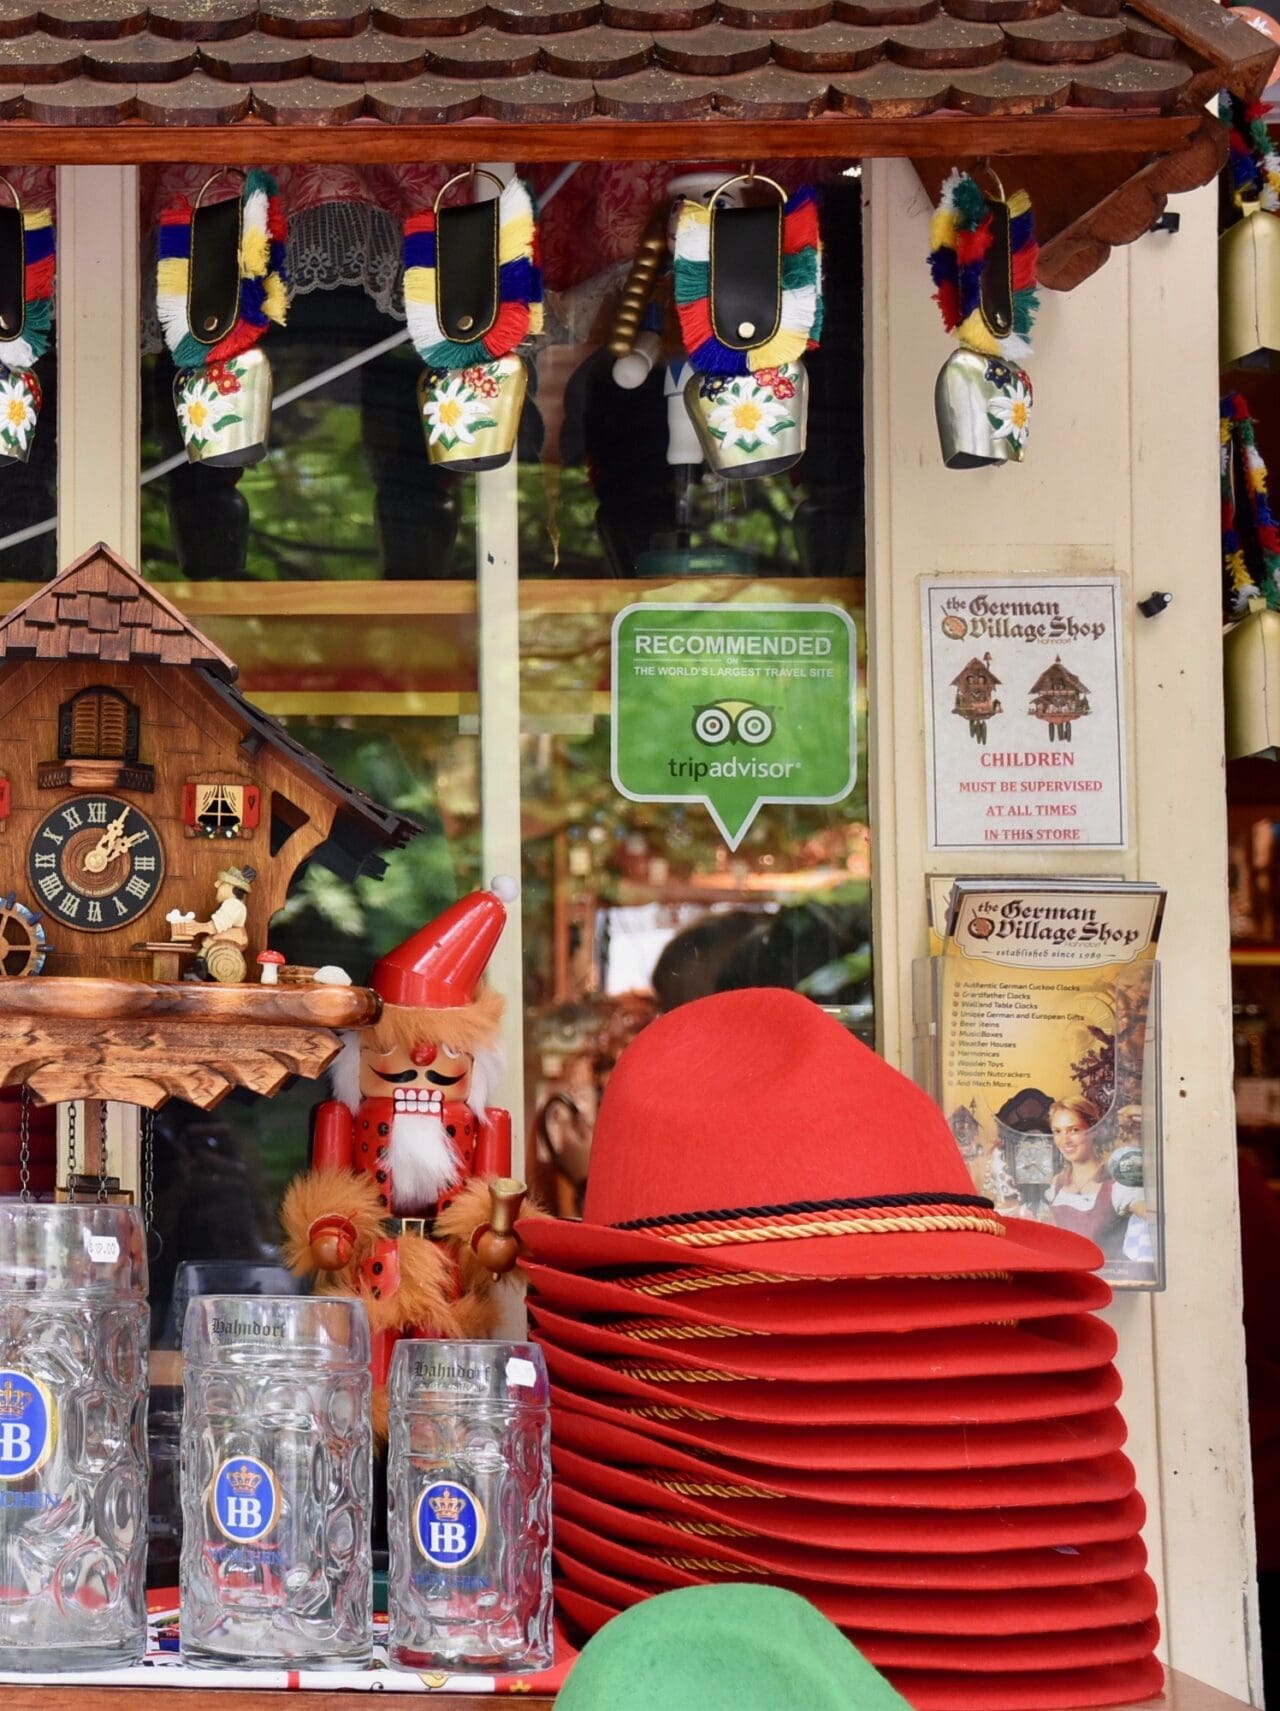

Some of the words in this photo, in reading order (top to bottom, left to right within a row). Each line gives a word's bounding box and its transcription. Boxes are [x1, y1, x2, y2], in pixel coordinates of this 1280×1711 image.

[946, 596, 966, 612] the
[969, 595, 1060, 616] German
[969, 617, 1047, 643] Village
[1049, 616, 1105, 641] Shop
[635, 635, 832, 656] RECOMMENDED
[726, 657, 739, 665] ON
[634, 667, 655, 676] THE
[658, 667, 708, 676] WORLD'S
[710, 667, 760, 677] LARGEST
[765, 668, 806, 678] TRAVEL
[809, 668, 833, 678] SITE
[980, 752, 1075, 767] CHILDREN
[959, 781, 996, 793] MUST
[1000, 781, 1017, 792] BE
[1020, 780, 1103, 792] SUPERVISED
[87, 802, 107, 823] XII
[986, 805, 1004, 816] AT
[1008, 805, 1032, 816] ALL
[1035, 804, 1077, 816] TIMES
[984, 829, 998, 840] IN
[1002, 829, 1033, 840] THIS
[1036, 828, 1081, 840] STORE
[978, 901, 999, 913] the
[1001, 899, 1097, 920] German
[995, 919, 1078, 945] Village
[1078, 921, 1140, 946] Shop
[996, 948, 1049, 958] established
[1052, 950, 1075, 959] since
[999, 982, 1028, 990] German
[1028, 983, 1055, 991] Cuckoo
[986, 1011, 1015, 1019] German
[1031, 1012, 1065, 1021] European
[1067, 1013, 1085, 1021] Gifts
[987, 1070, 1031, 1078] Nutcrackers
[226, 1496, 262, 1528] HB
[429, 1521, 467, 1553] HB
